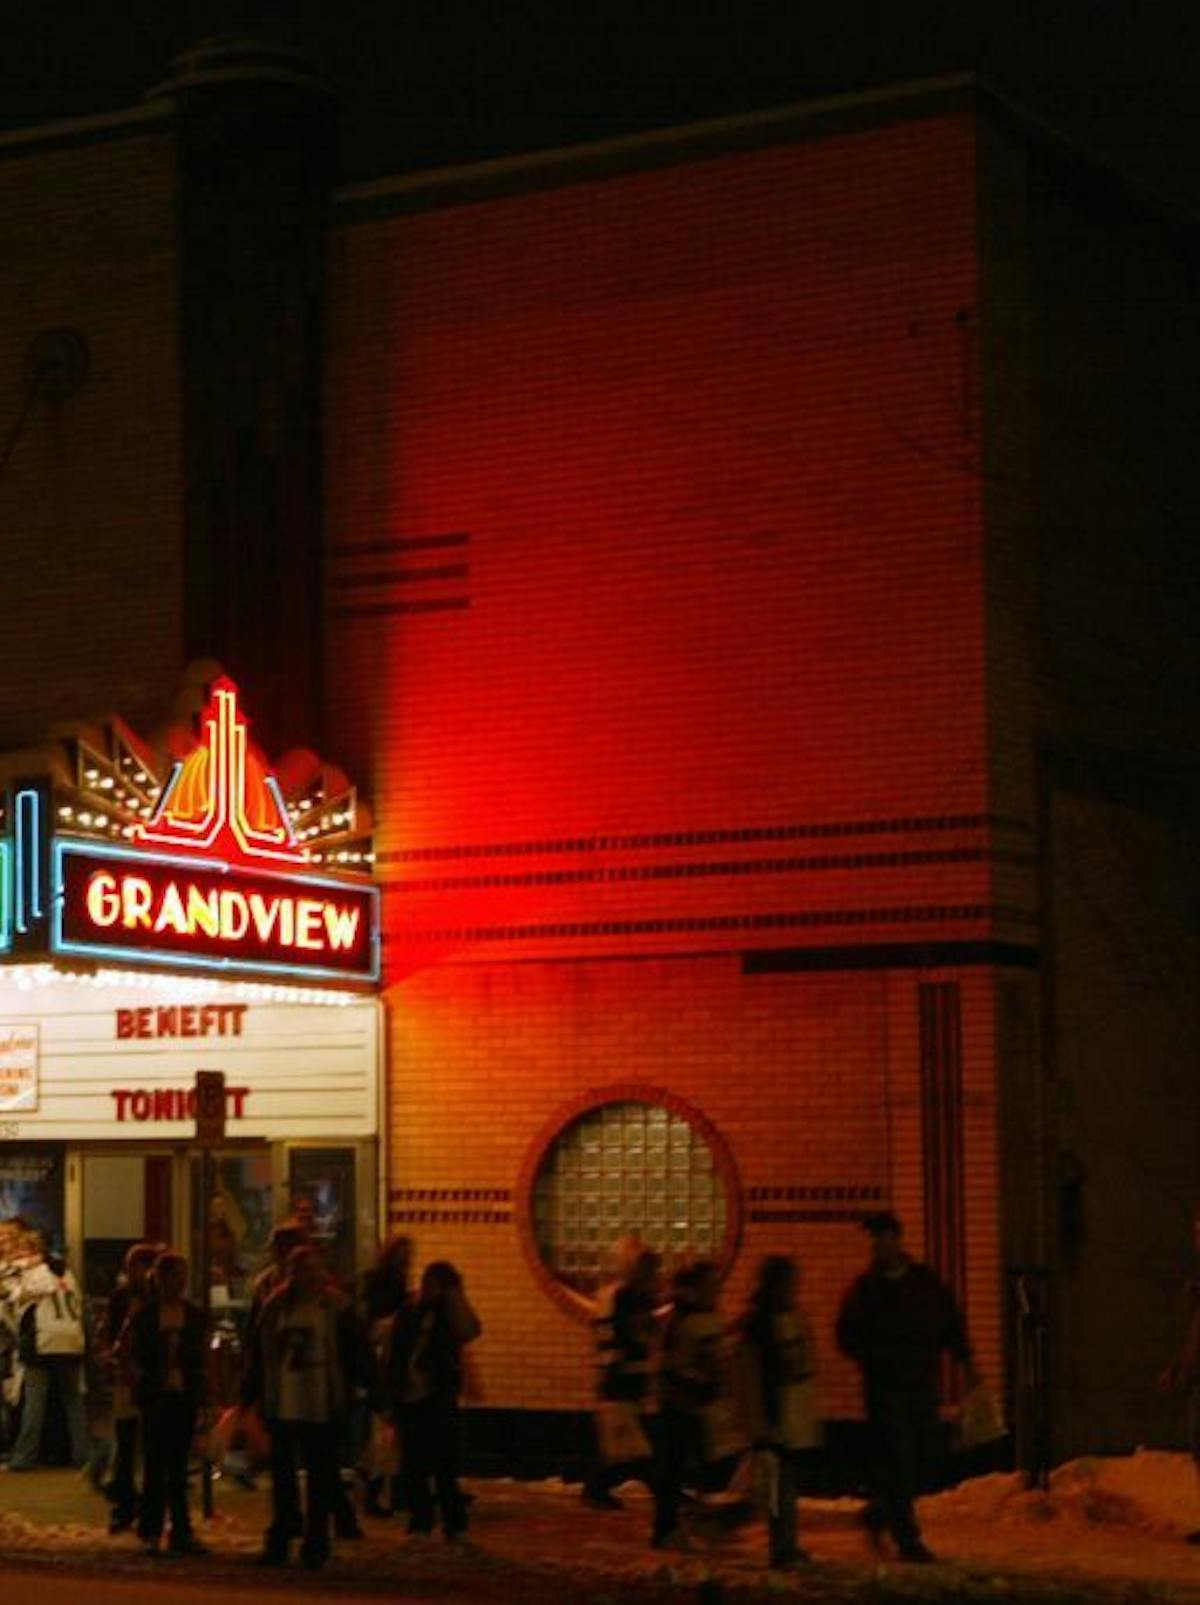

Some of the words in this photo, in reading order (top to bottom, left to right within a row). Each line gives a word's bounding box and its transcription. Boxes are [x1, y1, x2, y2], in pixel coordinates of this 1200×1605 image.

[87, 872, 360, 949] GRANDVIEW
[115, 1004, 248, 1040] BENEFIT
[111, 1087, 250, 1122] TONIT
